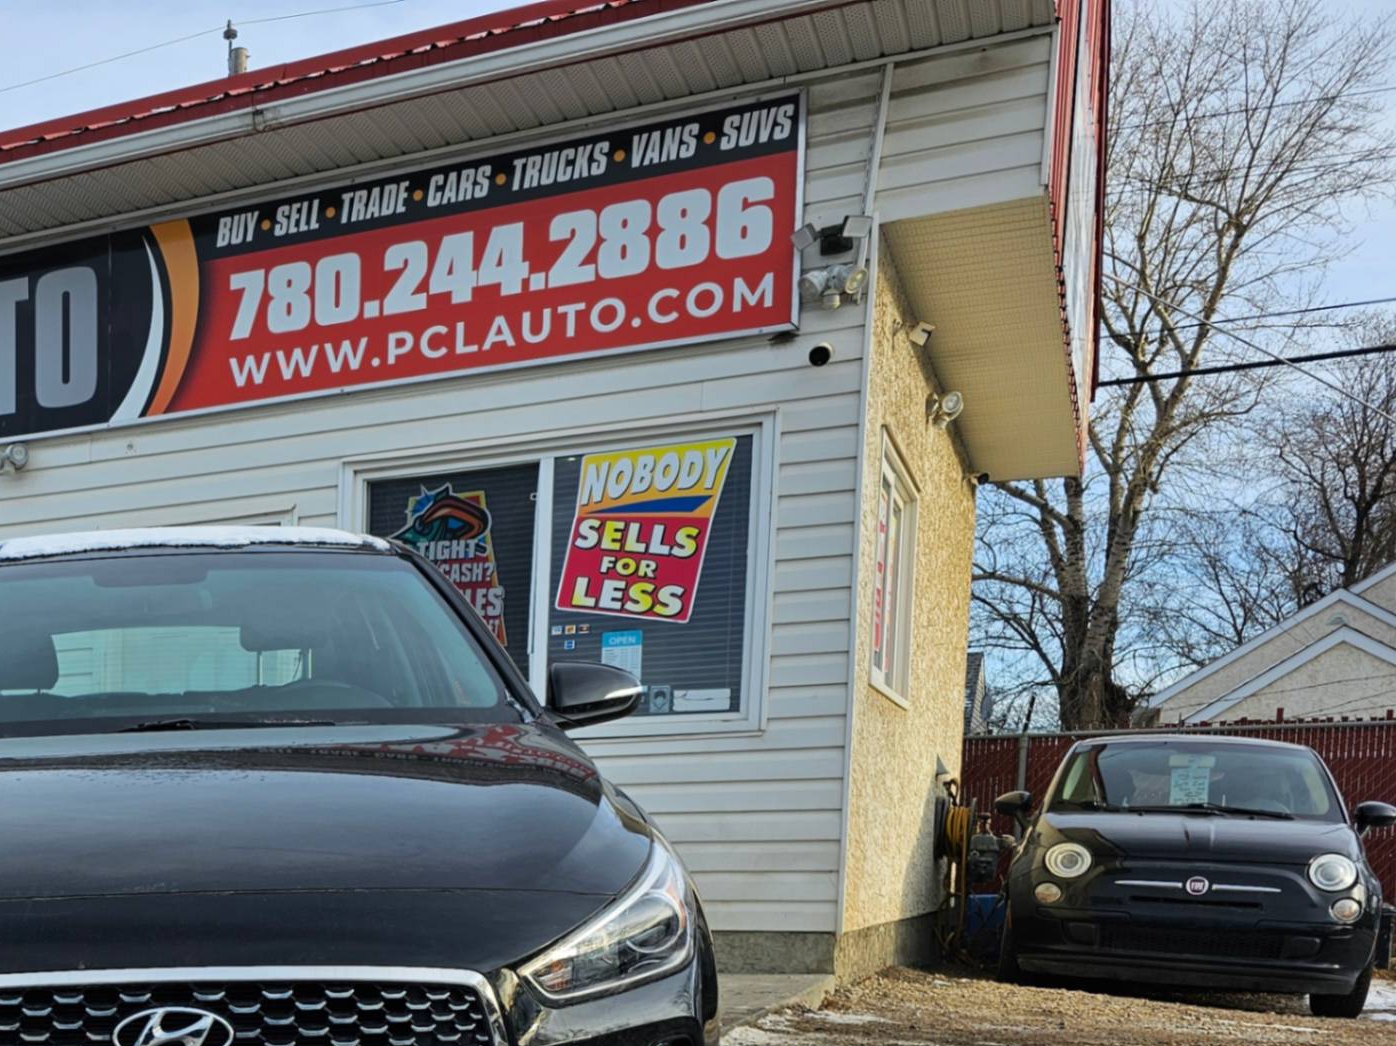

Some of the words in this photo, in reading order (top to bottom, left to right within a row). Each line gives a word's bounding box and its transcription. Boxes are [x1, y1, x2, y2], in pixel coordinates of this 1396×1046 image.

[216, 210, 259, 249] BUY
[274, 199, 320, 236] SELL
[340, 181, 408, 225] TRADE
[427, 165, 492, 208] CARS
[512, 141, 610, 192] TRUCKS
[630, 123, 699, 169] VANS
[720, 104, 795, 151] SUVS
[229, 176, 775, 342] 780.244.2886
[229, 272, 774, 389] WWW.PCLAUTO.COM
[580, 446, 731, 506] NOBODY
[417, 539, 477, 560] TIGHT
[574, 518, 700, 558] SELLS
[600, 556, 657, 579] FOR
[571, 576, 685, 618] LESS
[608, 635, 636, 645] OPEN
